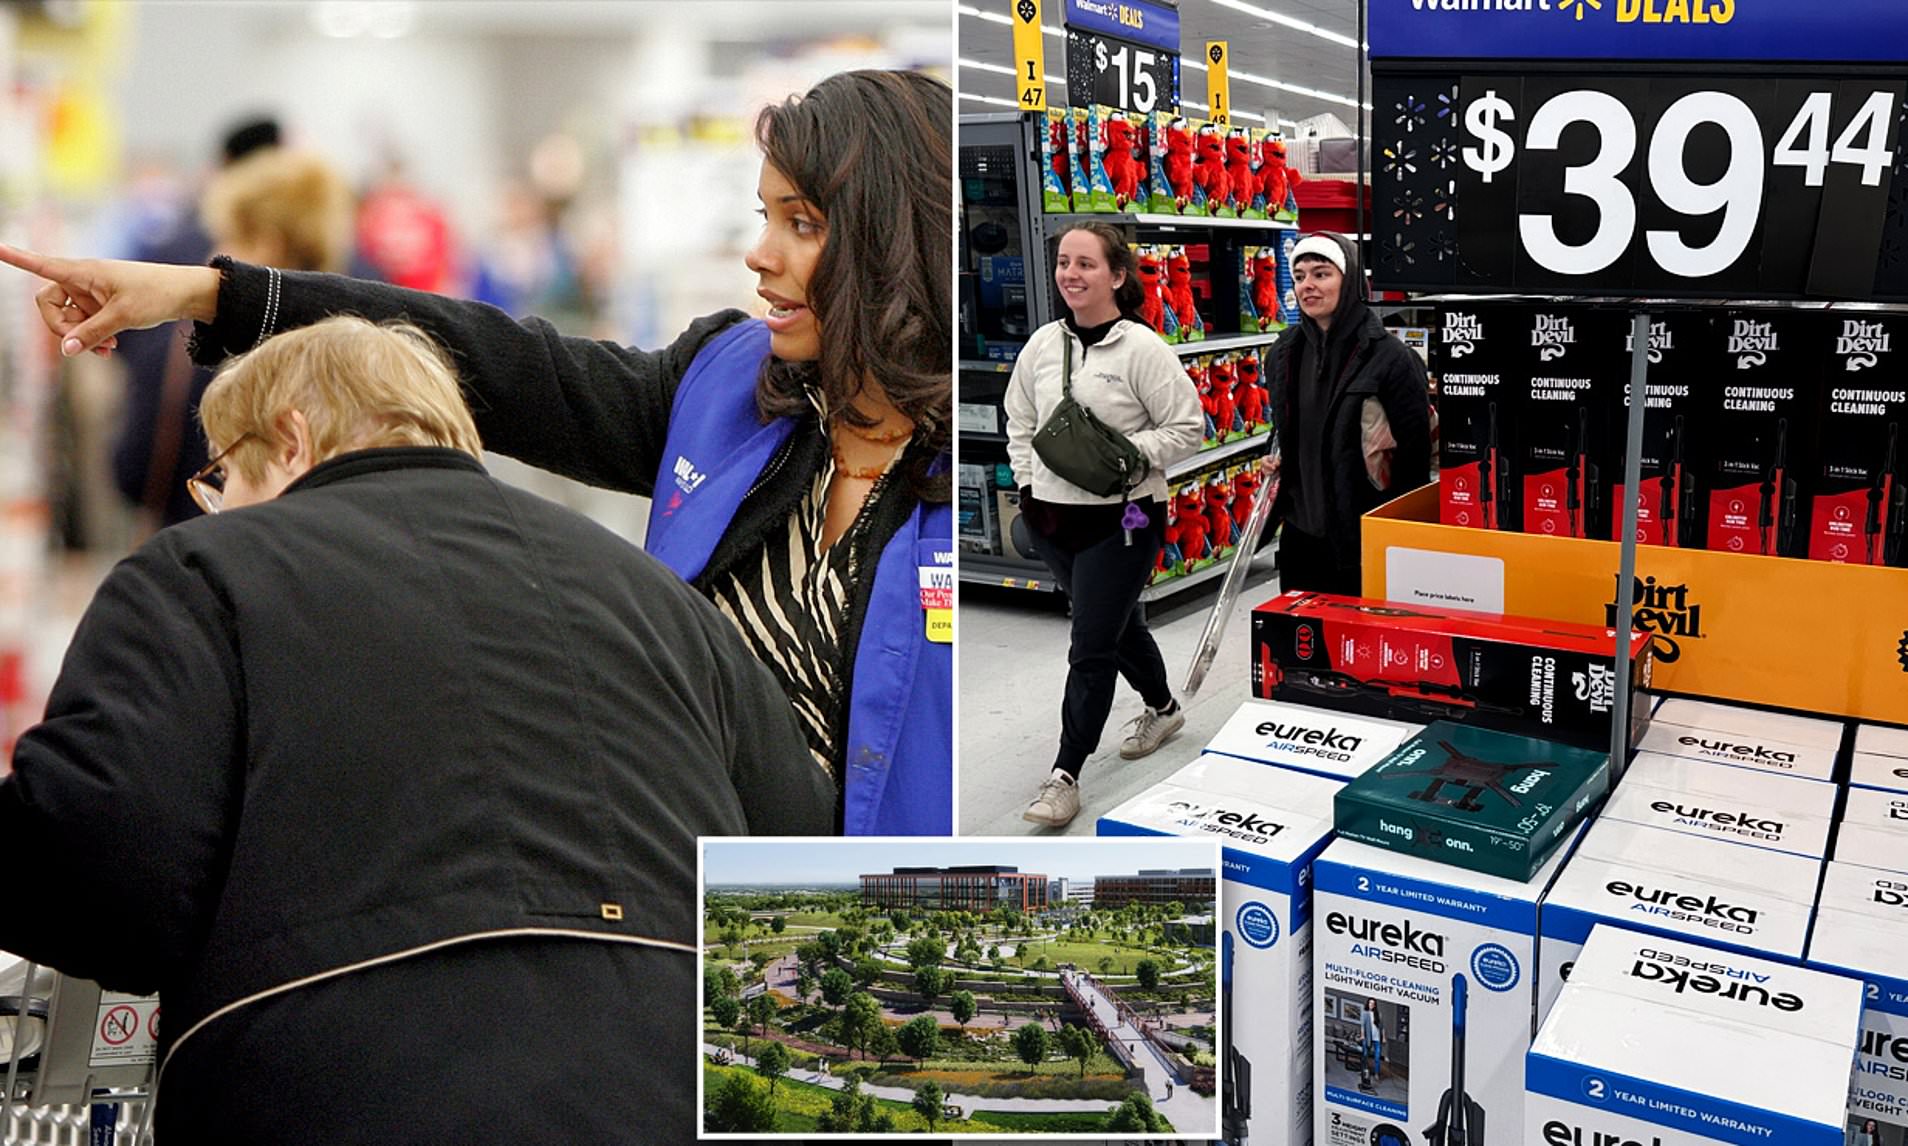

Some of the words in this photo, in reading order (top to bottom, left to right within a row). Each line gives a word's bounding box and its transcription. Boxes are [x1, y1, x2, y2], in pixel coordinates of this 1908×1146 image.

[1119, 4, 1143, 30] DEALS
[1022, 88, 1042, 106] 47
[1445, 312, 1477, 328] Dirt
[1535, 314, 1568, 330] Dirt
[1734, 319, 1772, 337] Dirt
[1843, 319, 1884, 338] Dirt
[1442, 323, 1484, 343] Devil
[1531, 326, 1576, 346] Devil
[1727, 332, 1778, 353] Devil
[1836, 333, 1890, 354] Devil
[1443, 373, 1500, 385] CONTINUOUS
[1531, 377, 1592, 390] CONTINUOUS
[1443, 385, 1486, 397] CLEANING
[1531, 389, 1576, 402] CLEANING
[1624, 384, 1689, 397] CTINUOUS
[1724, 386, 1794, 399] CONTINUOUS
[1832, 388, 1906, 403] CONTINUOUS
[1724, 399, 1776, 412] CLEANING
[1830, 401, 1886, 416] CLEANING
[1529, 655, 1543, 706] CLEANING
[1541, 657, 1556, 724] CONTINUOUS
[1588, 662, 1609, 714] Devil
[1255, 721, 1363, 752] eureka
[1266, 741, 1352, 763] AIRSPEED
[1678, 736, 1796, 763] eureka
[1699, 750, 1793, 769] AIRSPEED
[1510, 769, 1552, 795] hang
[1650, 801, 1784, 834] eureka
[1380, 819, 1413, 841] hang
[1673, 818, 1781, 842] AIRSPEED
[1357, 876, 1369, 892] 2
[1375, 884, 1399, 895] YEAR
[1400, 889, 1435, 903] LIMITED
[1436, 896, 1487, 913] WARRANTY
[1606, 881, 1757, 924] eureka
[1630, 903, 1753, 935] AIRSPEED
[1326, 911, 1444, 957] eureka
[1350, 943, 1445, 974] AIRSPEED
[1639, 948, 1771, 984] AIRSPEED
[1325, 962, 1389, 983] MULTI-FLOOR
[1389, 976, 1440, 995] CLEANING
[1325, 971, 1394, 994] LIGHTWEIGHT
[1396, 988, 1440, 1006] VACUUM
[1631, 959, 1804, 1012] eureka
[1867, 983, 1880, 1000] 2
[1330, 1112, 1342, 1126] 3
[1374, 1102, 1407, 1117] CLEANING
[1588, 1079, 1604, 1098] 2
[1614, 1089, 1646, 1106] YEAR
[1649, 1099, 1697, 1119] LIMITED
[1699, 1112, 1773, 1138] WARRANTY
